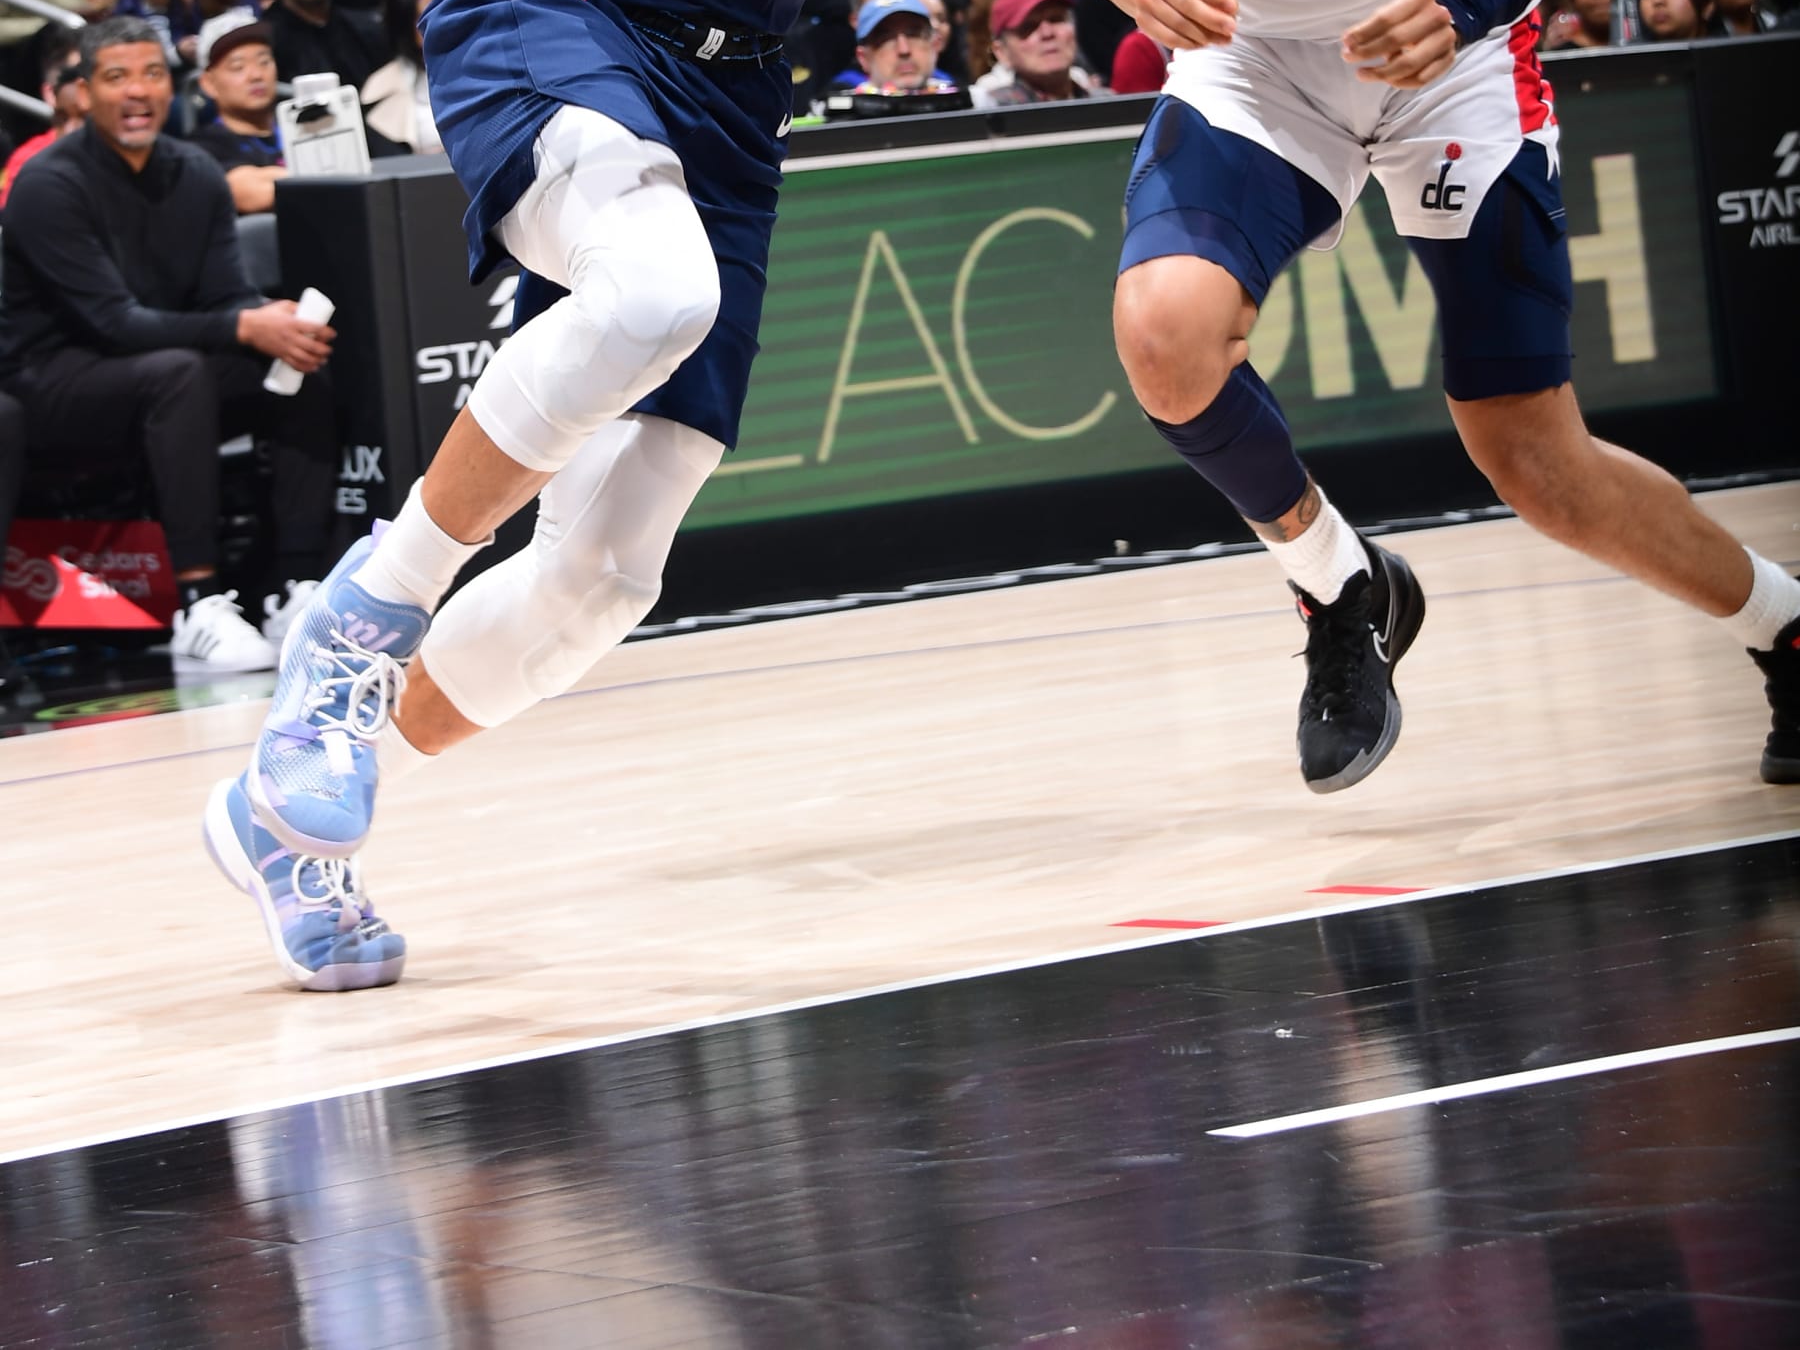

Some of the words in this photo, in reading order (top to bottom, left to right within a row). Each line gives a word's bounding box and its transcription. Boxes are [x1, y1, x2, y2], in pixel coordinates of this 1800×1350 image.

[1421, 158, 1467, 210] dc
[416, 337, 510, 384] STA
[339, 445, 385, 482] UX
